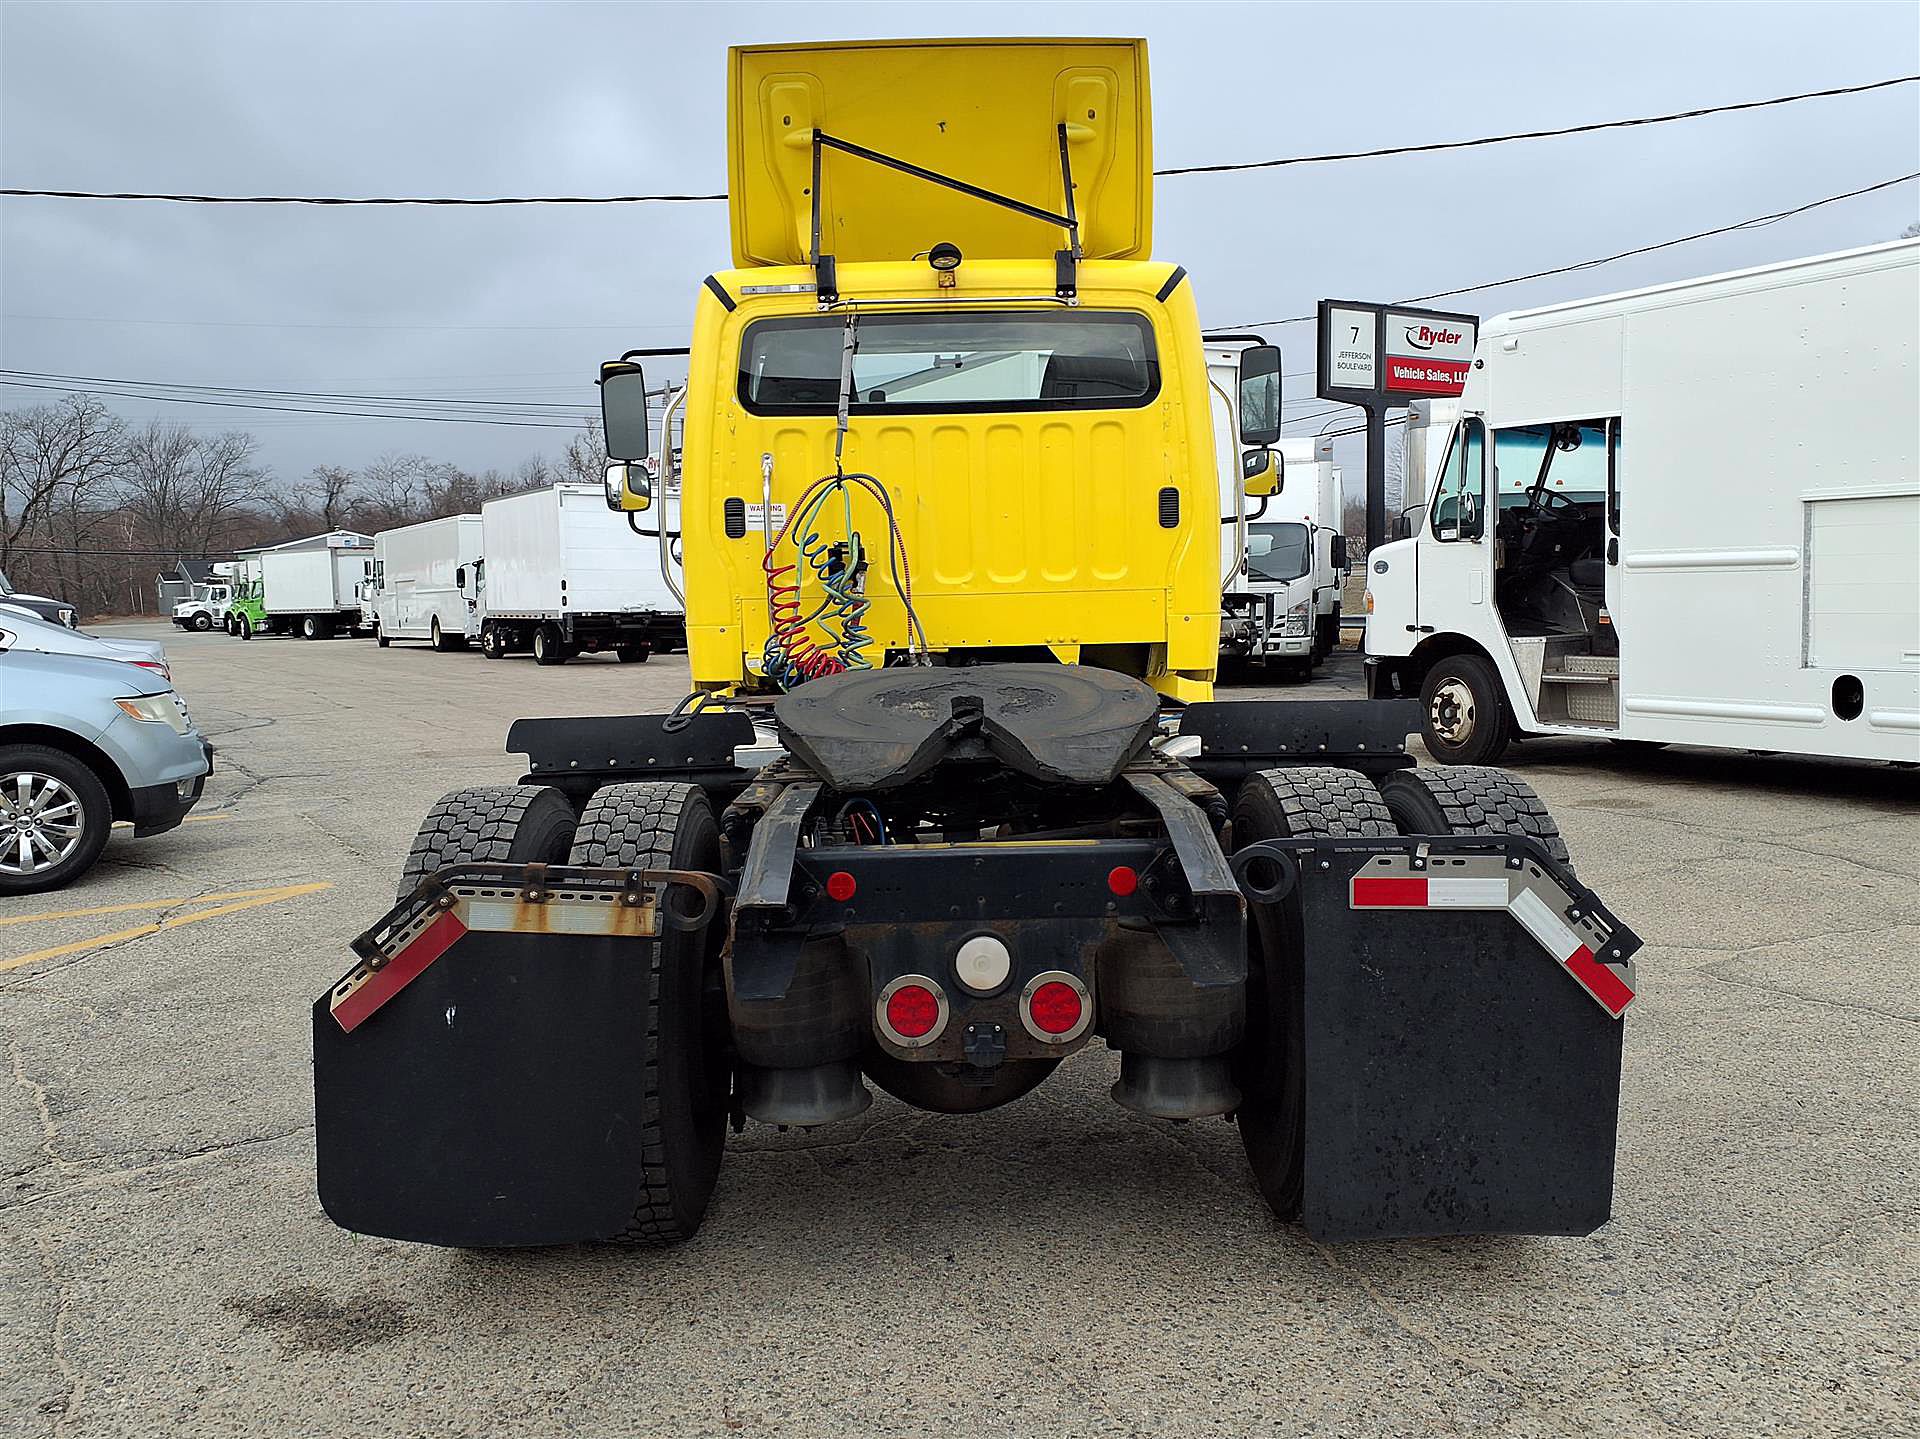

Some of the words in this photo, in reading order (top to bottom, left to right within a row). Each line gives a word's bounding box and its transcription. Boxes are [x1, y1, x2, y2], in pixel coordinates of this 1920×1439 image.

[1350, 326, 1360, 344] 7
[1418, 325, 1462, 345] Ryder
[1337, 351, 1372, 360] JEFFERSON
[1337, 361, 1372, 371] BOULEVARD
[1393, 365, 1425, 380] Vehicle
[1426, 368, 1452, 384] Sales,
